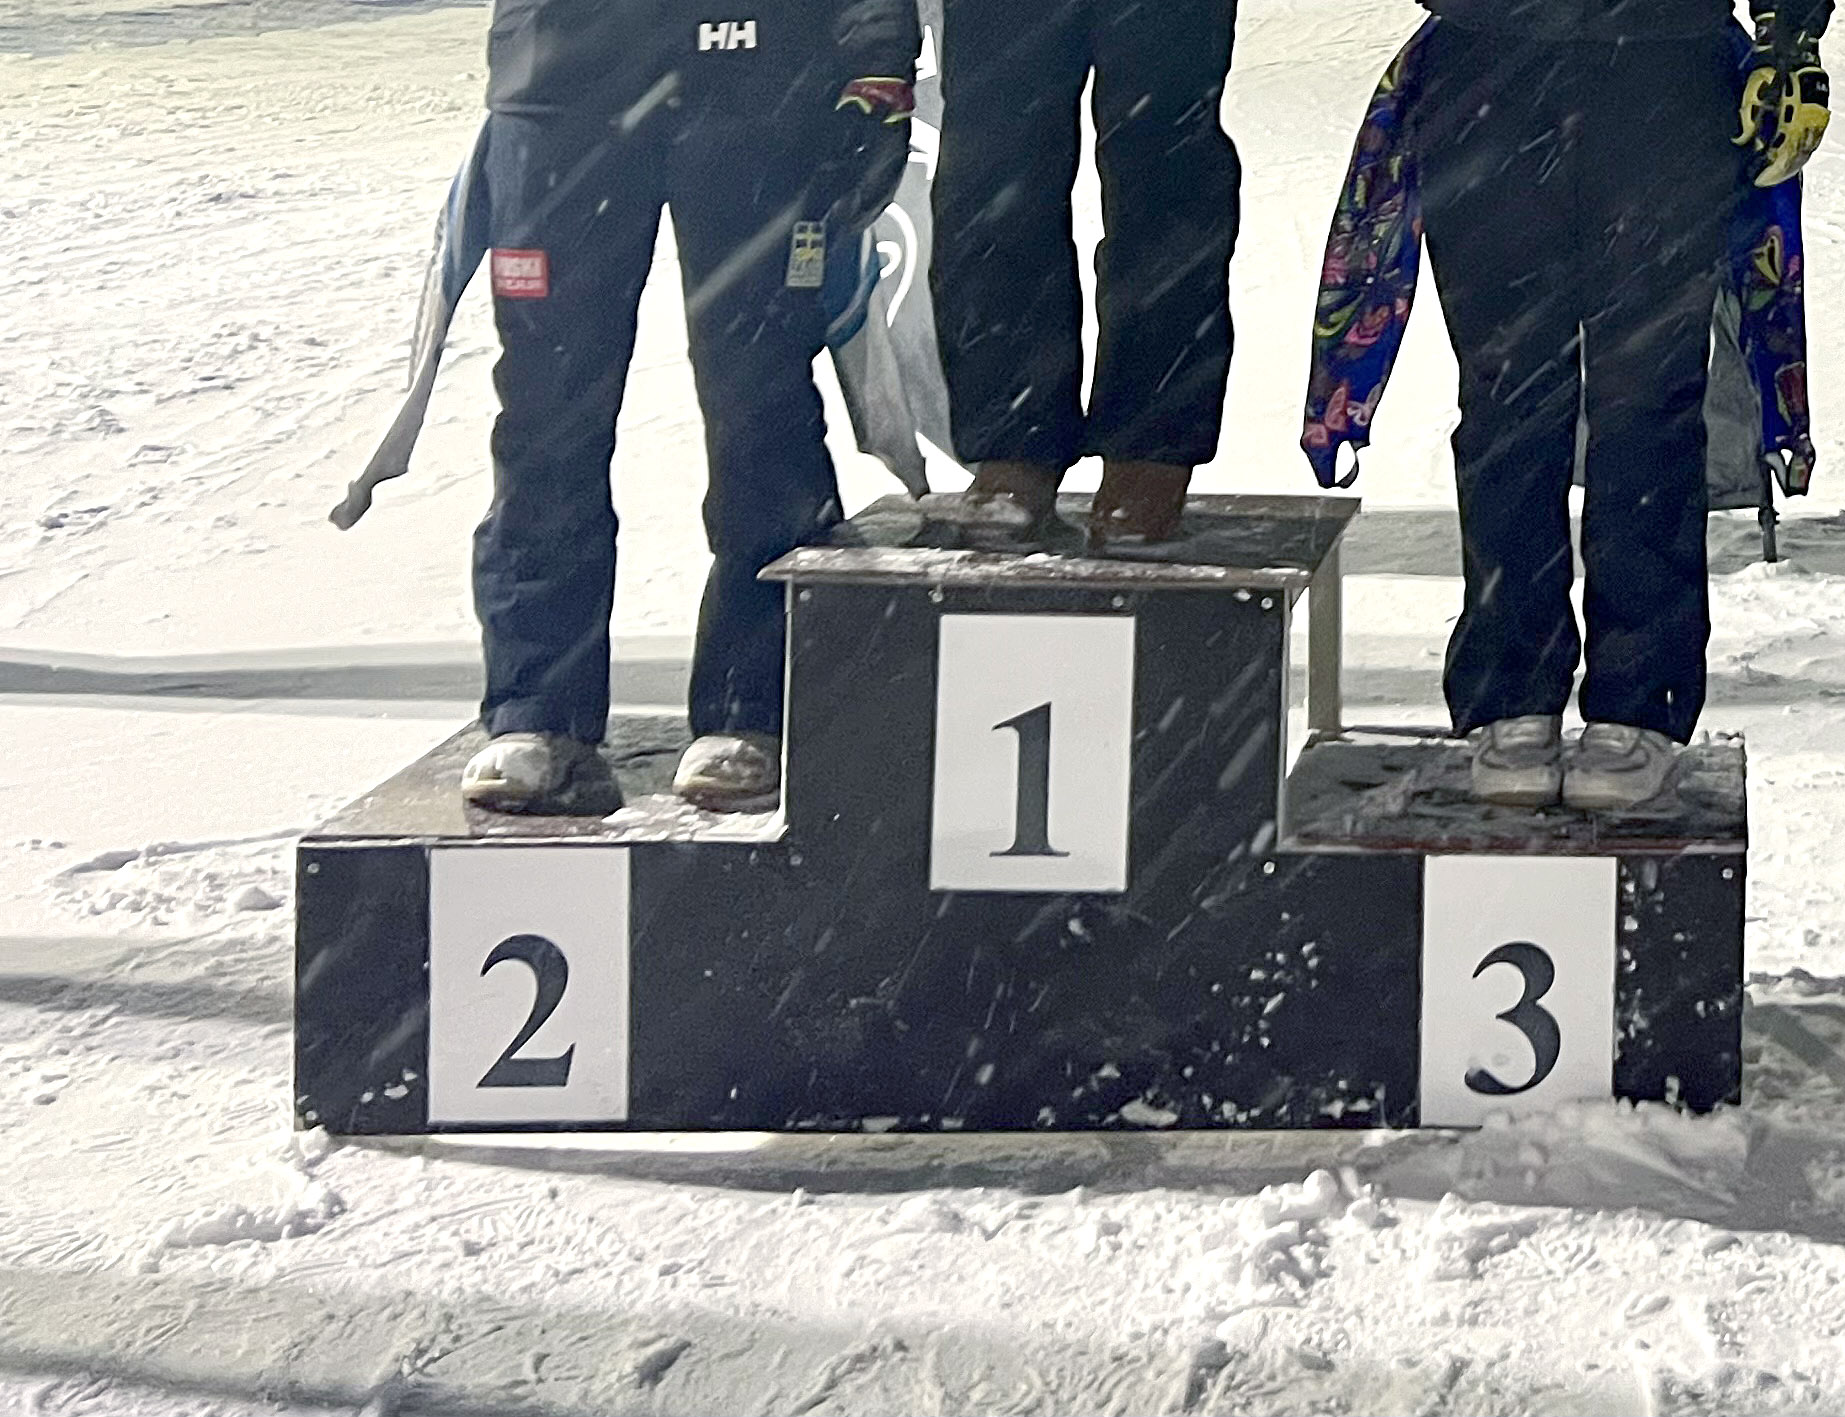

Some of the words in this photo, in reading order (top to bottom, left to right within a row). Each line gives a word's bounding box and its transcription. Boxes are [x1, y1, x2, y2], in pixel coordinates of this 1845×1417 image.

[699, 21, 757, 51] HH
[989, 701, 1070, 857] 1
[476, 933, 576, 1089] 2
[1464, 941, 1561, 1095] 3
